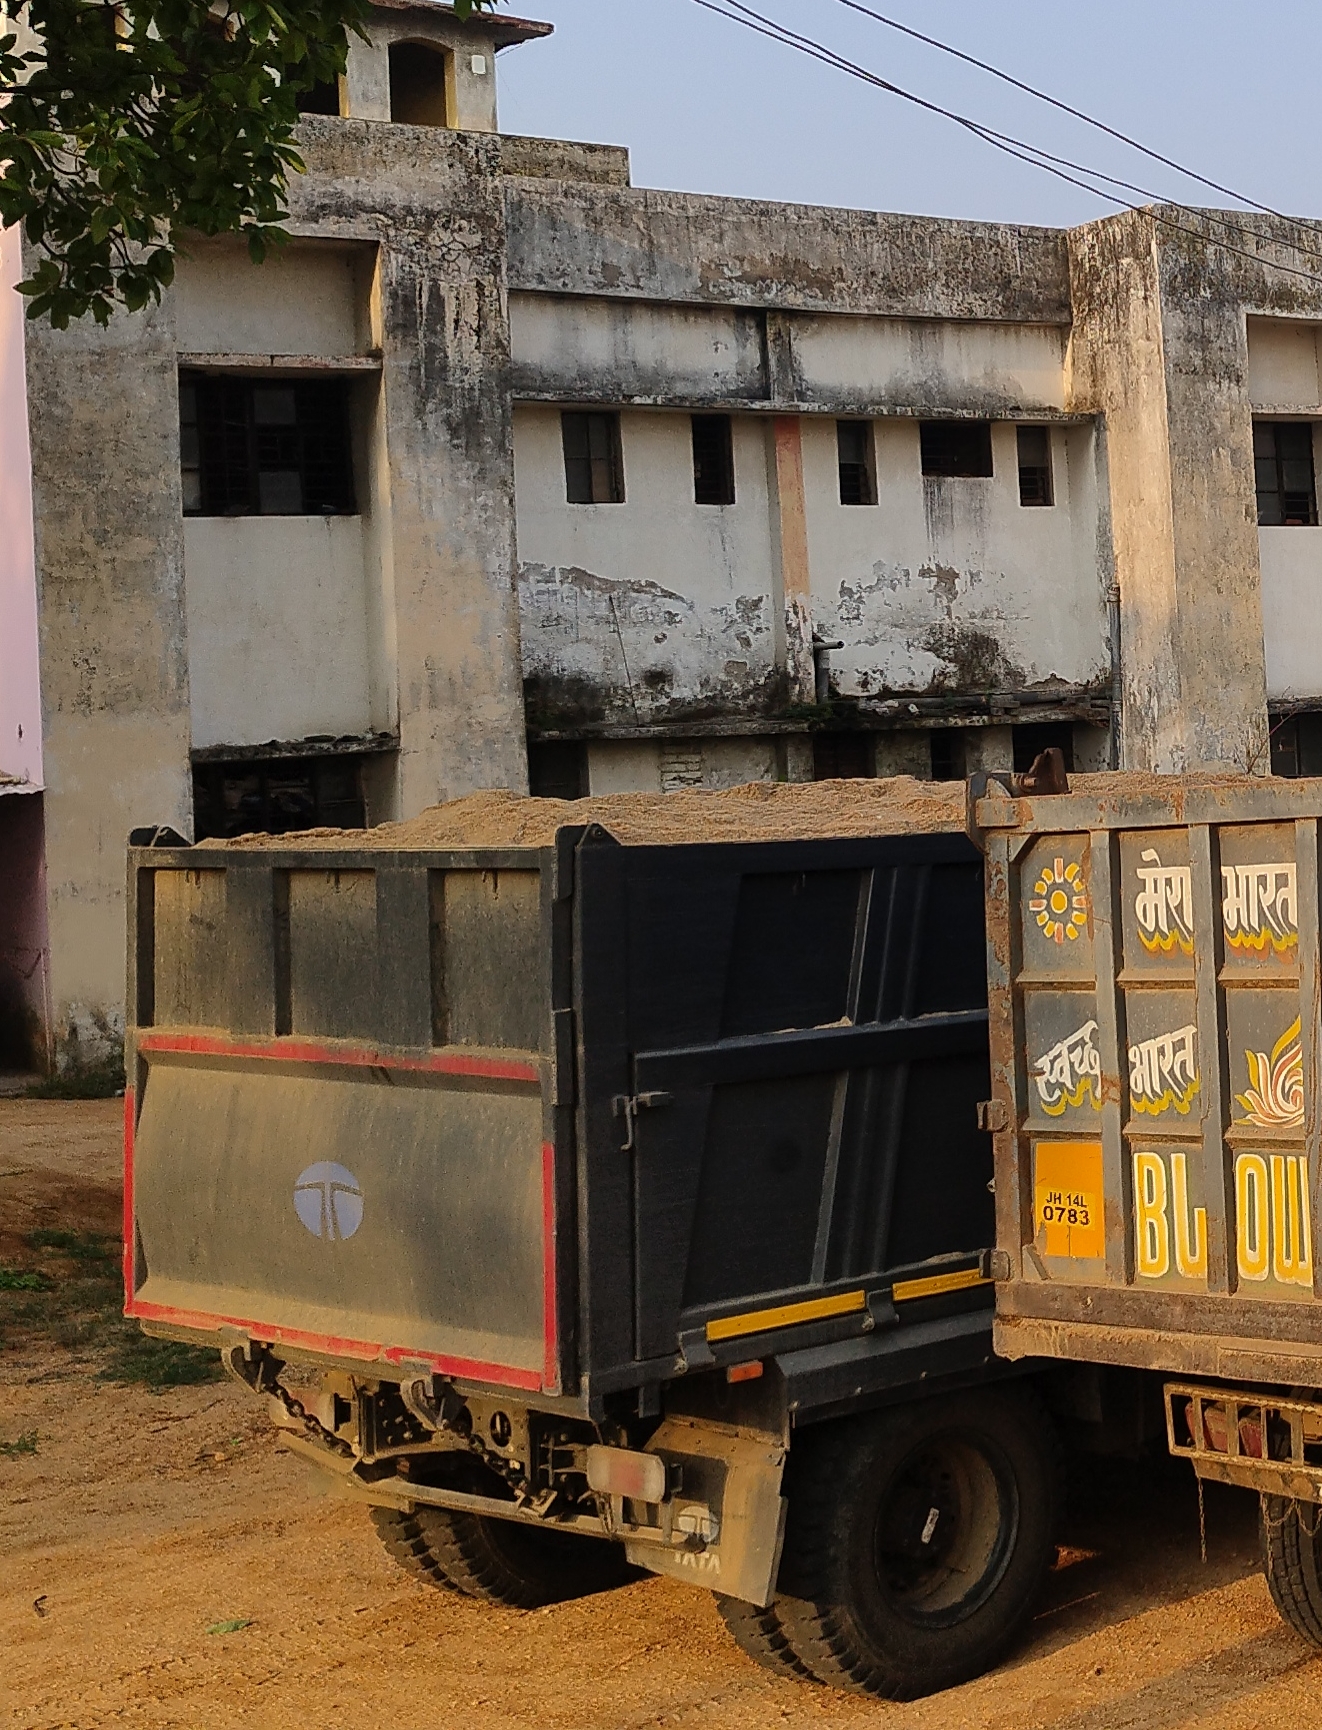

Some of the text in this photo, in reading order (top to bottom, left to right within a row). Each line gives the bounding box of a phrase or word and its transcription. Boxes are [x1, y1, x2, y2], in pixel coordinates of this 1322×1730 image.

[1135, 848, 1193, 941] मेरा
[1220, 862, 1298, 938] भारत
[1128, 1024, 1197, 1101] भारत
[1043, 1205, 1091, 1226] 0783
[1046, 1191, 1088, 1208] JH 14L
